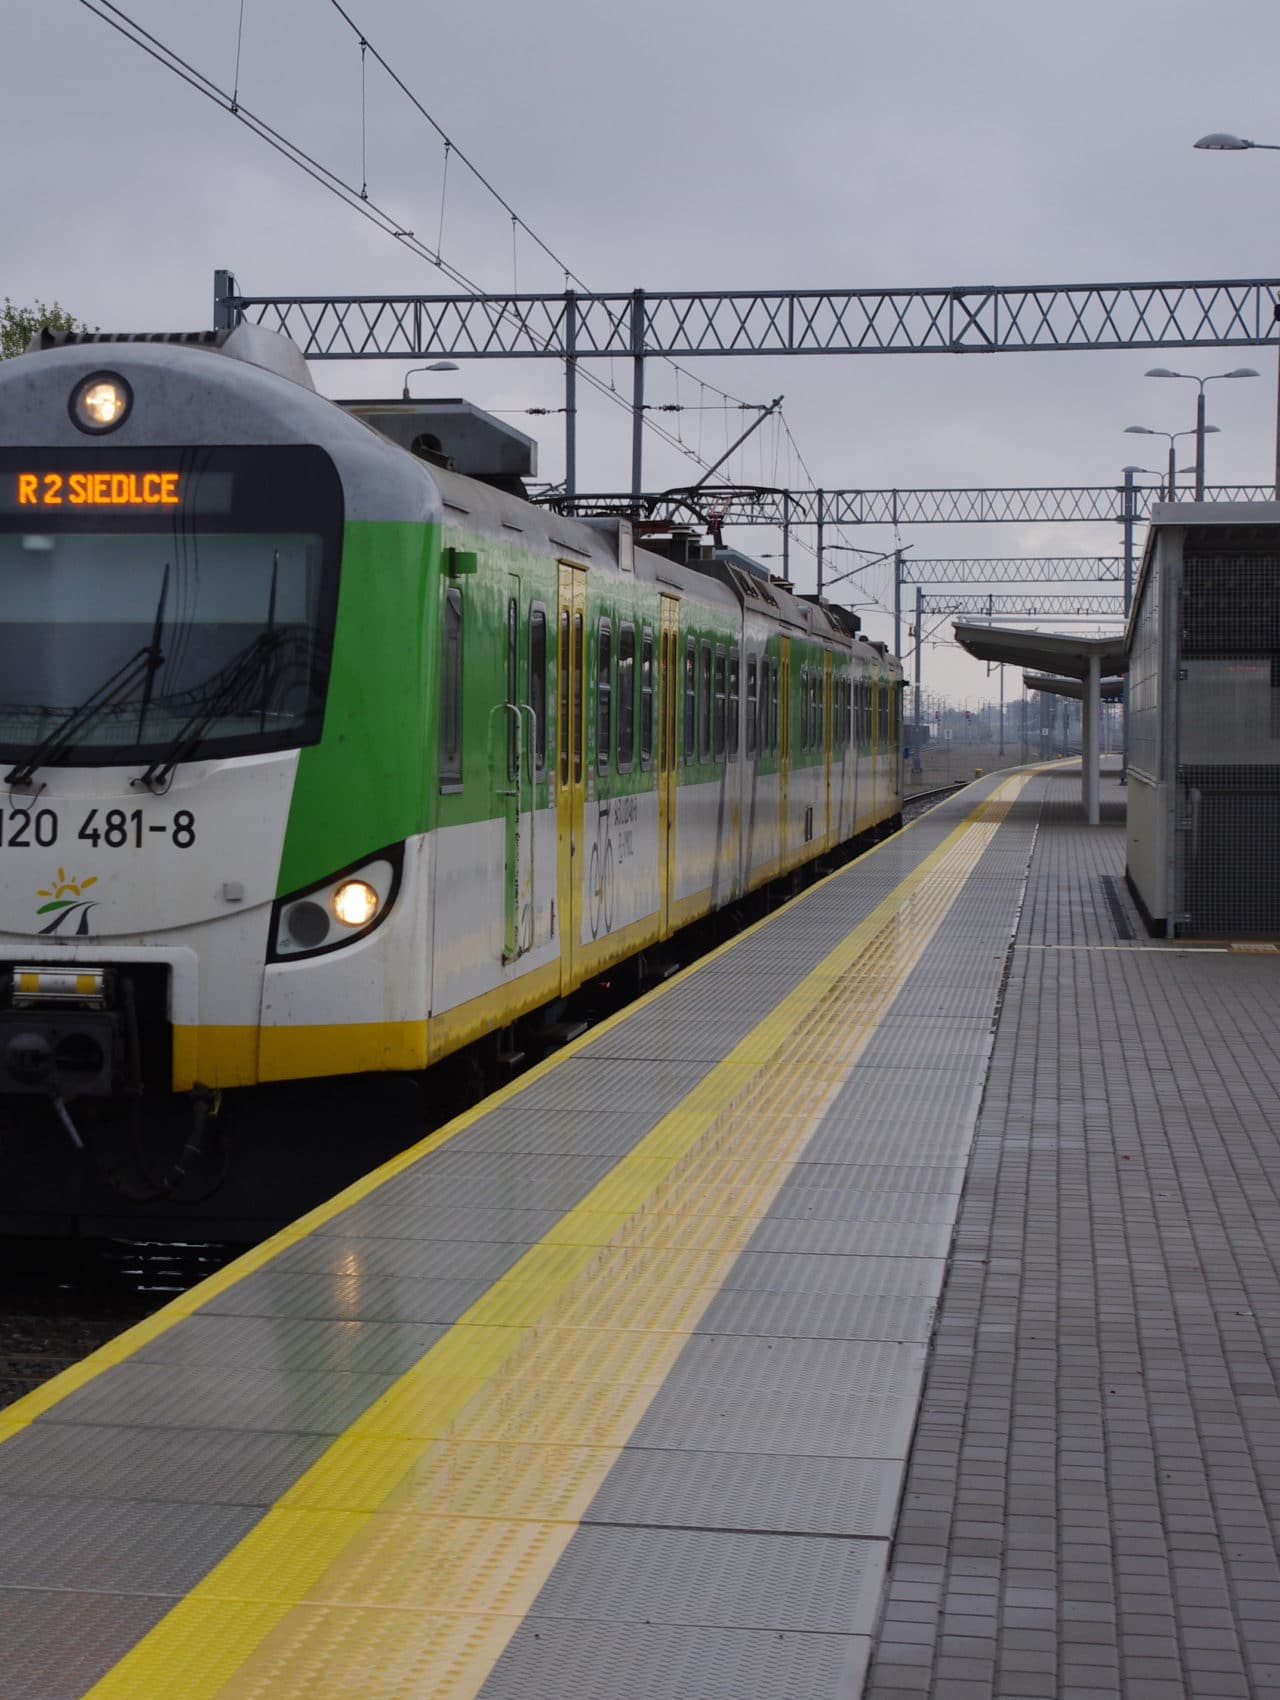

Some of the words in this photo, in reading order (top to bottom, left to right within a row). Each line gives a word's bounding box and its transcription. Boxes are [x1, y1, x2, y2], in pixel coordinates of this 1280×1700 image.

[18, 473, 37, 504] R
[43, 473, 62, 504] 2
[68, 473, 179, 504] SIEDLCE
[78, 808, 196, 848] 481-8
